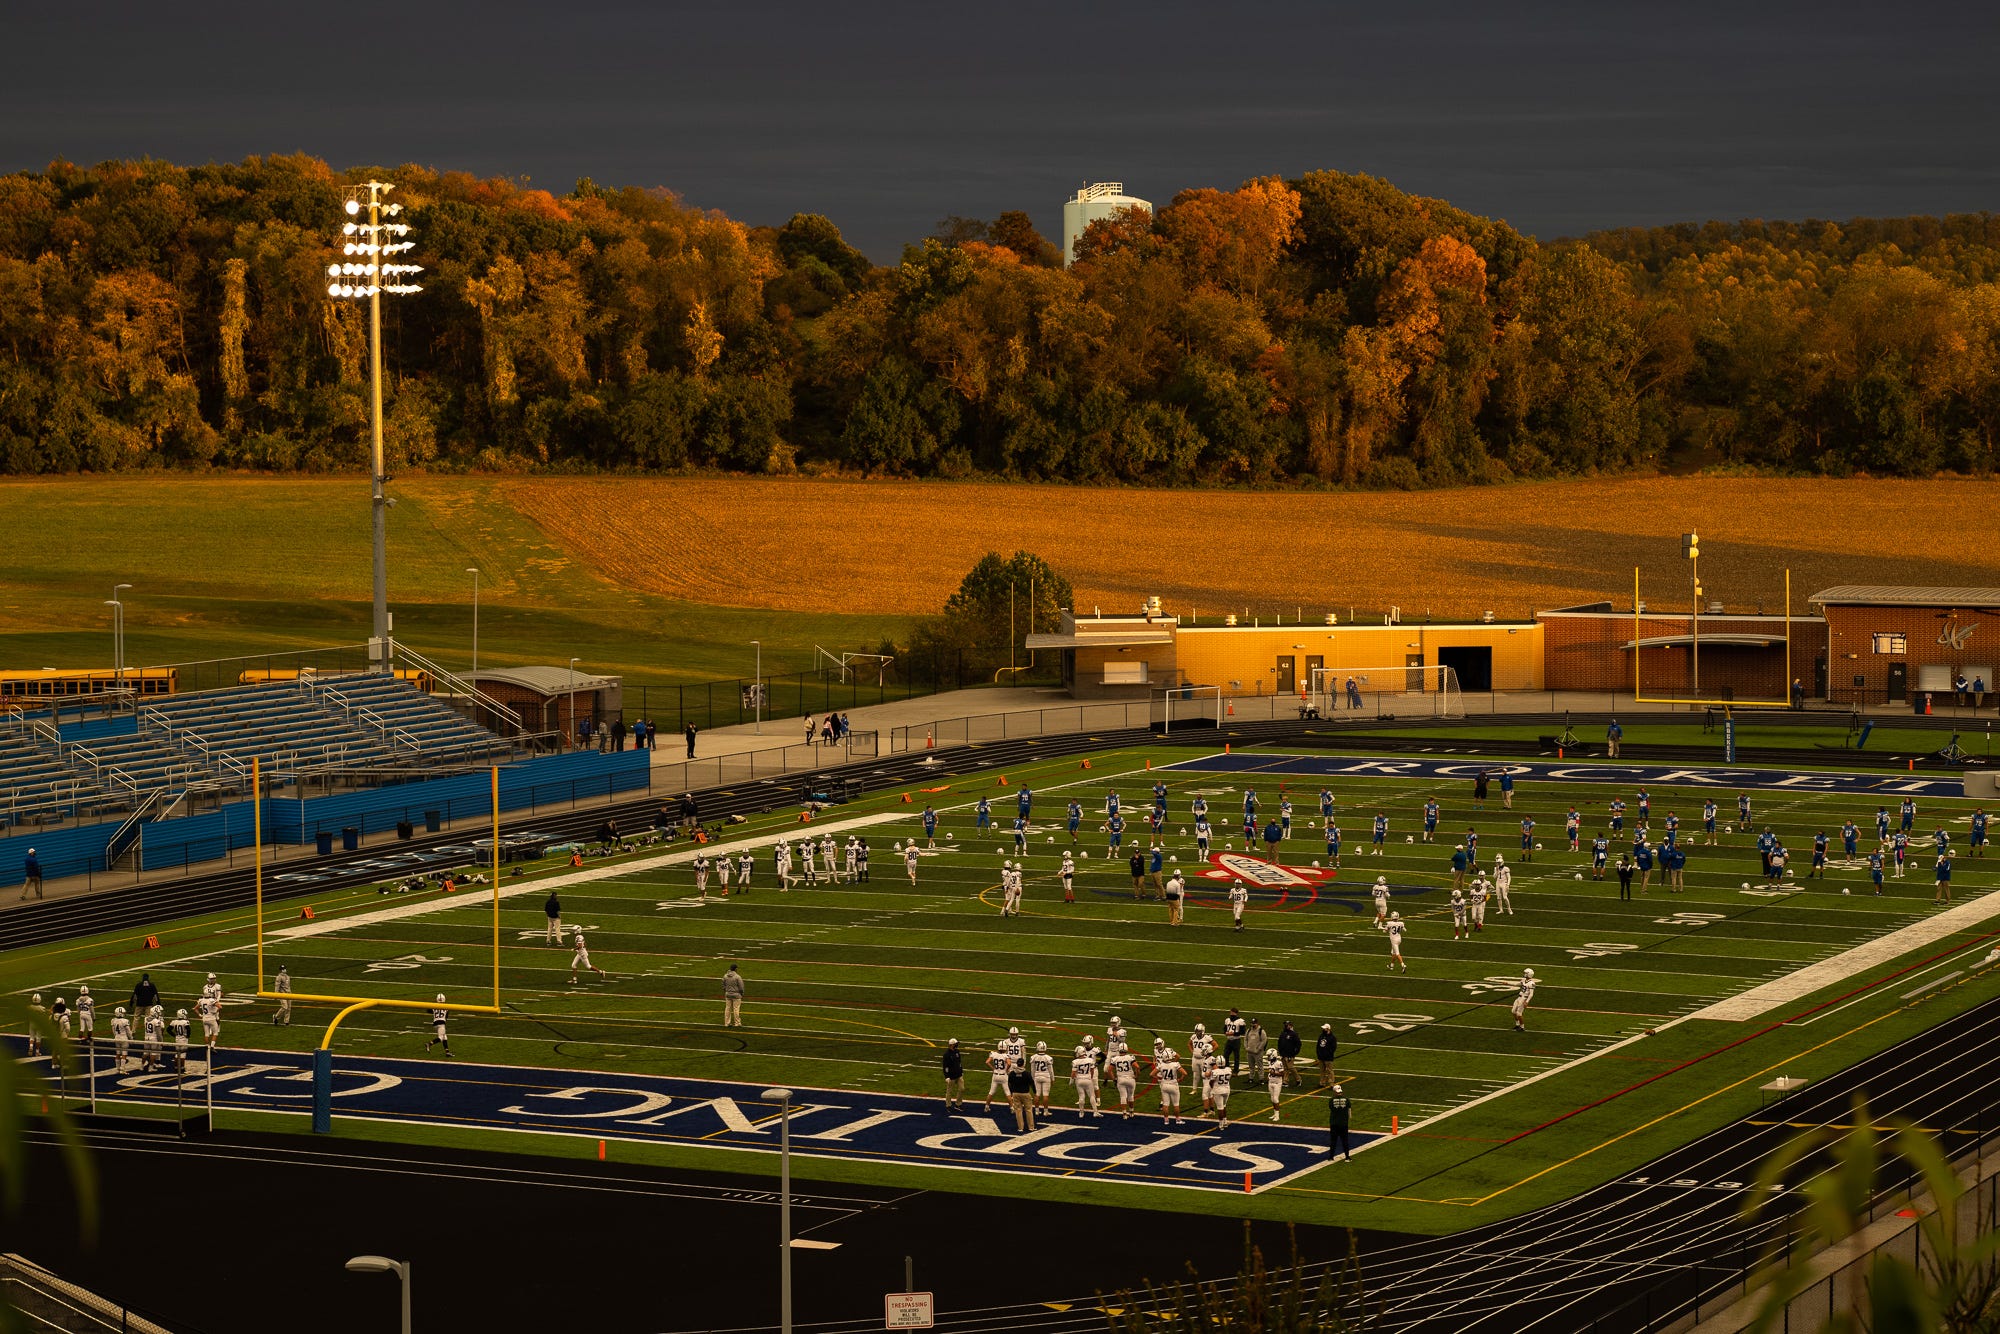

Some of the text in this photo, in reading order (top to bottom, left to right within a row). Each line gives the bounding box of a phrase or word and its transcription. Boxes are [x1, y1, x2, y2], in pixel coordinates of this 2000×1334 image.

[1653, 912, 1726, 926] 50
[1565, 942, 1640, 957] 40
[1349, 1013, 1435, 1031] 20
[1008, 1045, 1019, 1055] 56
[1194, 1041, 1204, 1049] 70
[1035, 1061, 1047, 1072] 72
[1078, 1063, 1090, 1074] 57
[1117, 1061, 1130, 1073] 53
[1163, 1069, 1174, 1080] 74
[1218, 1074, 1230, 1085] 55
[498, 1086, 1329, 1174] SPRING
